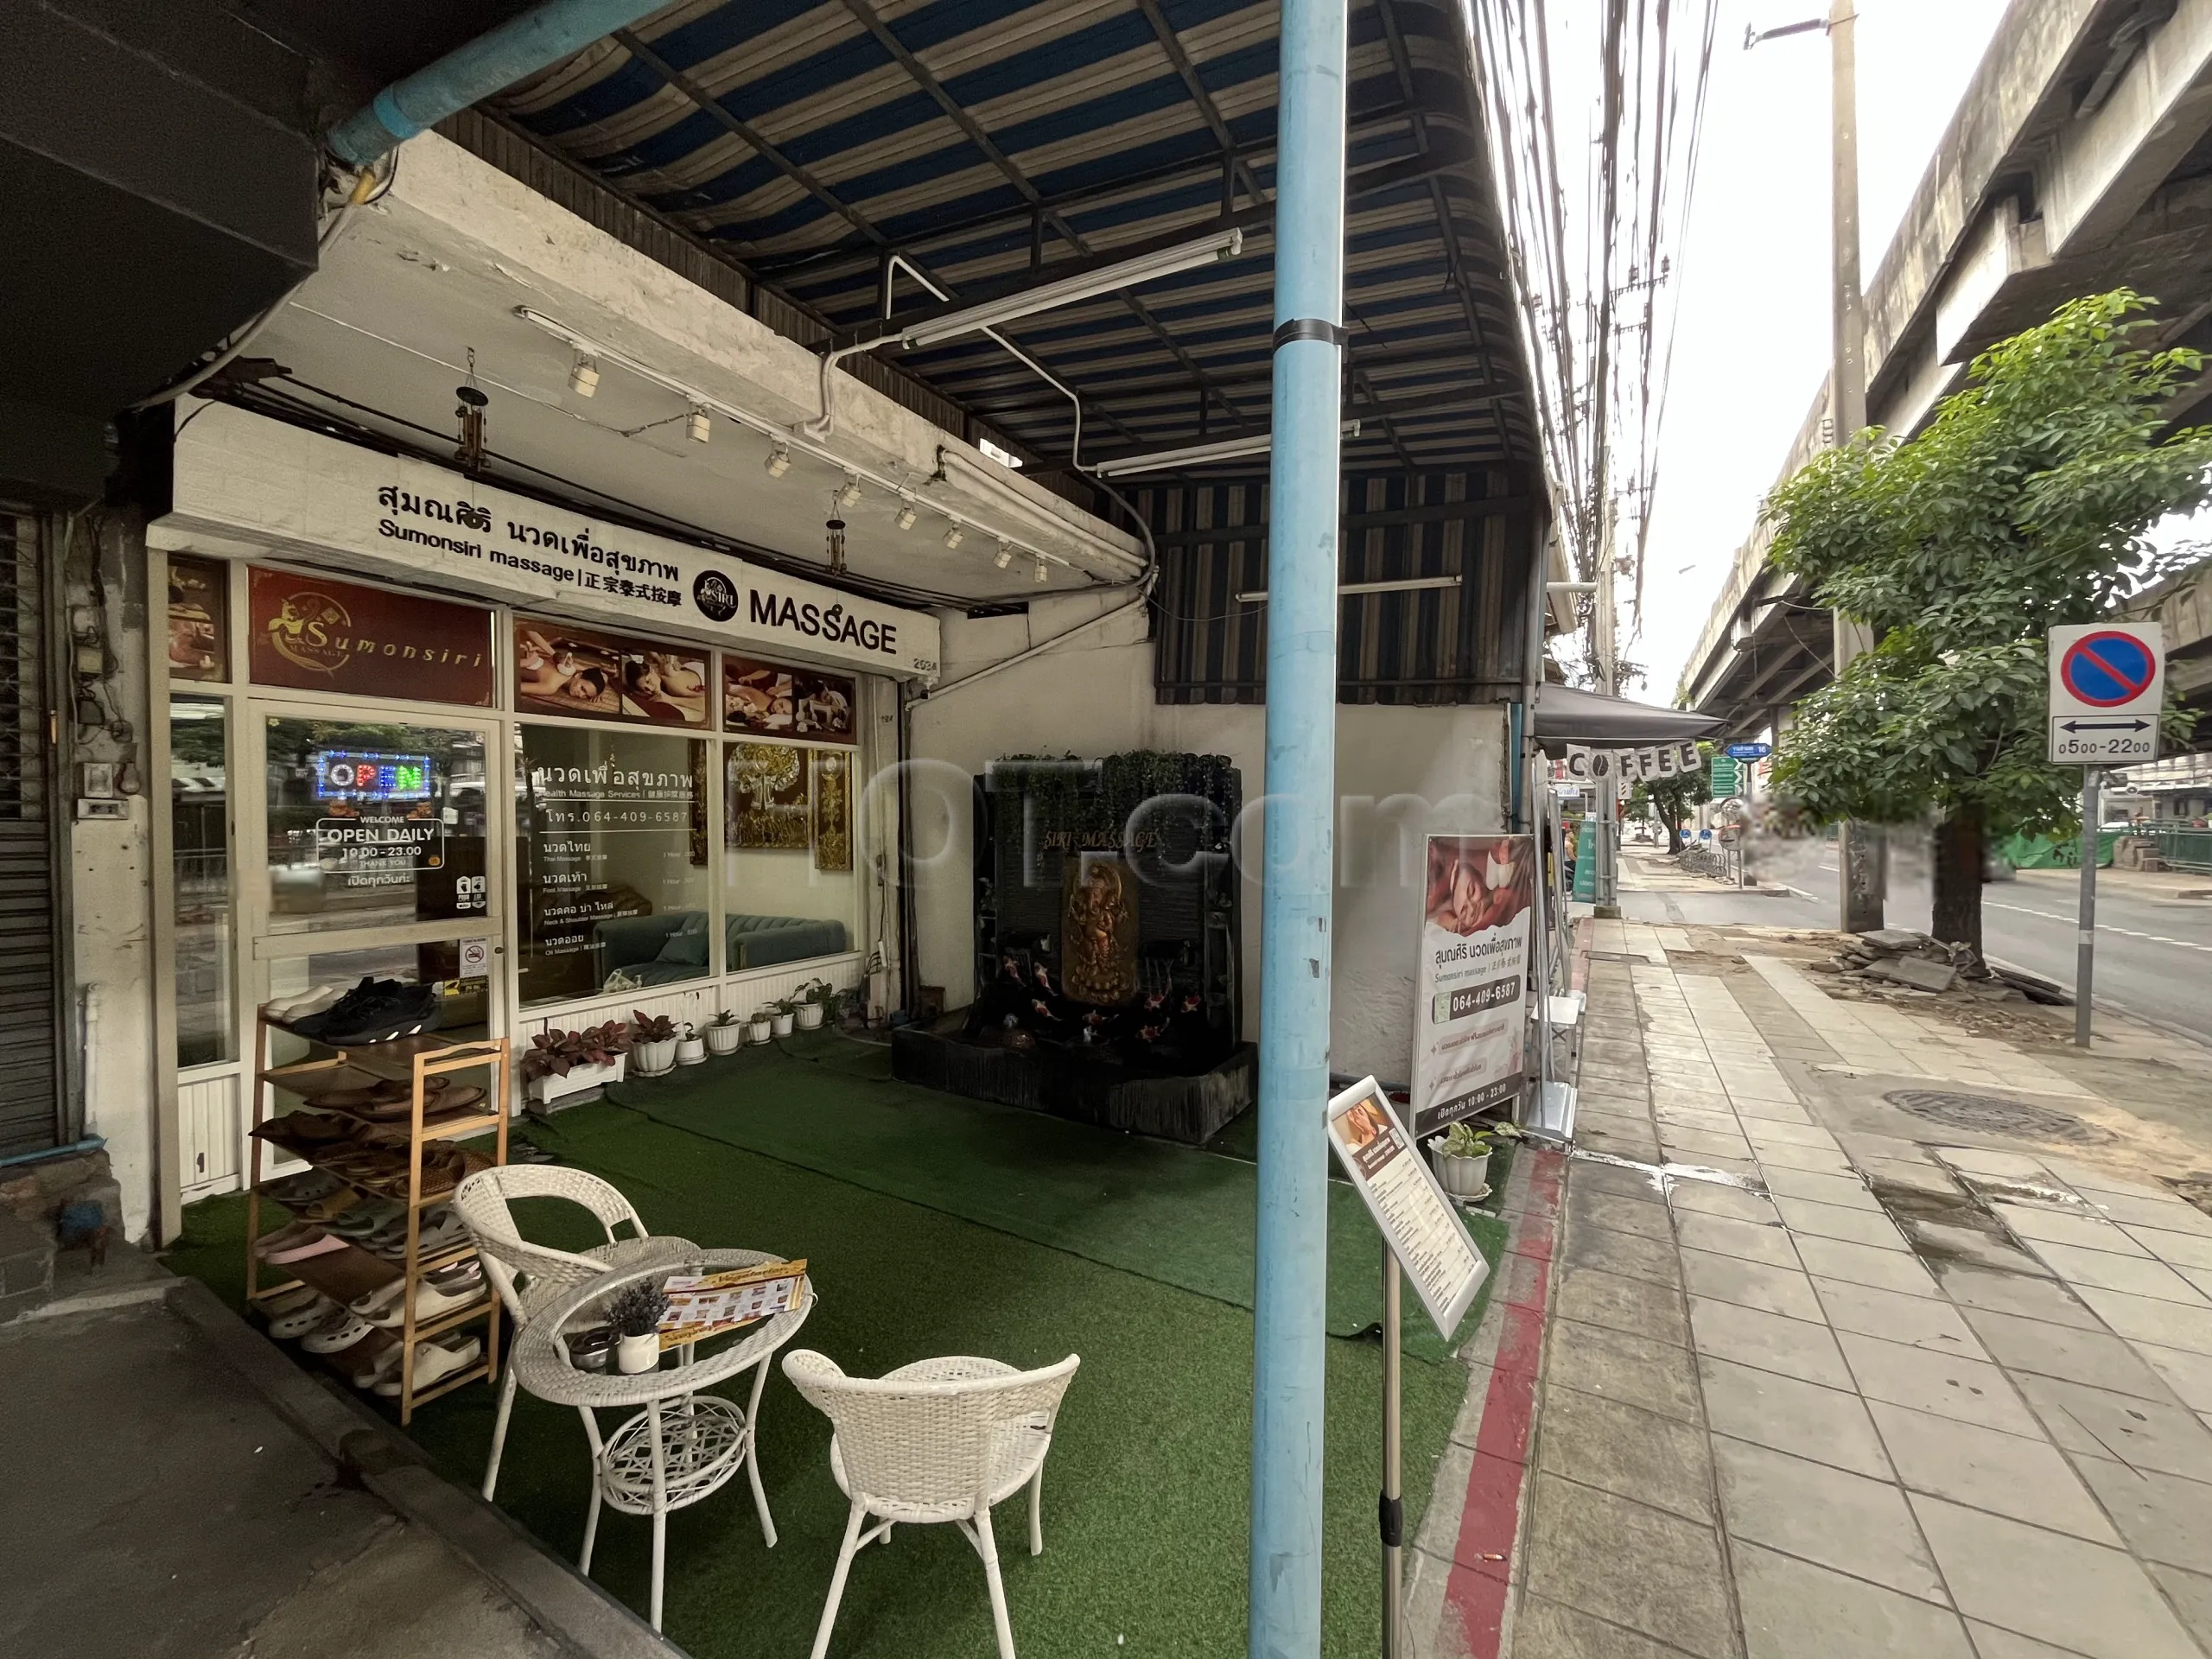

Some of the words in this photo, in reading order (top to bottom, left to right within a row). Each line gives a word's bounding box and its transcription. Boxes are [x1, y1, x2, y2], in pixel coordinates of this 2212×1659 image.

[378, 519, 481, 558] Sumonsiri
[490, 550, 574, 582] massage
[584, 571, 683, 607] 正宗泰式按摩
[507, 521, 679, 582] นวดเพื่อสุขภาพ
[749, 589, 897, 655] MASSAGE
[305, 621, 483, 667] Sumonsiri
[1569, 742, 1697, 777] COFFEE
[330, 764, 423, 790] OPEN
[538, 761, 693, 791] นวดเพื่อสุขภาพ
[569, 790, 605, 799] Massage
[607, 790, 641, 798] Services
[360, 816, 404, 824] WELCOME
[327, 829, 379, 842] OPEN
[387, 828, 435, 841] DAILY
[543, 841, 591, 853] นวดไทย
[1044, 830, 1074, 849] SIRI
[1081, 831, 1157, 852] MASSAGE
[387, 847, 422, 856] 23.00
[543, 871, 588, 884] นวดเท้า
[543, 906, 576, 917] นวดคอ
[594, 900, 613, 911] ไหล่
[545, 933, 584, 947] นวดออย
[1435, 944, 1467, 969] สุมณศิริ
[1469, 932, 1522, 957] นวดเพื่อสุขภาพ
[1434, 970, 1464, 982] Sumonsiri
[1465, 966, 1486, 977] massage
[1452, 982, 1516, 1012] 064-409-6587
[1437, 1101, 1466, 1120] เปิดทุกวัน
[1468, 1092, 1485, 1107] 10:00
[1490, 1084, 1506, 1097] 23:00
